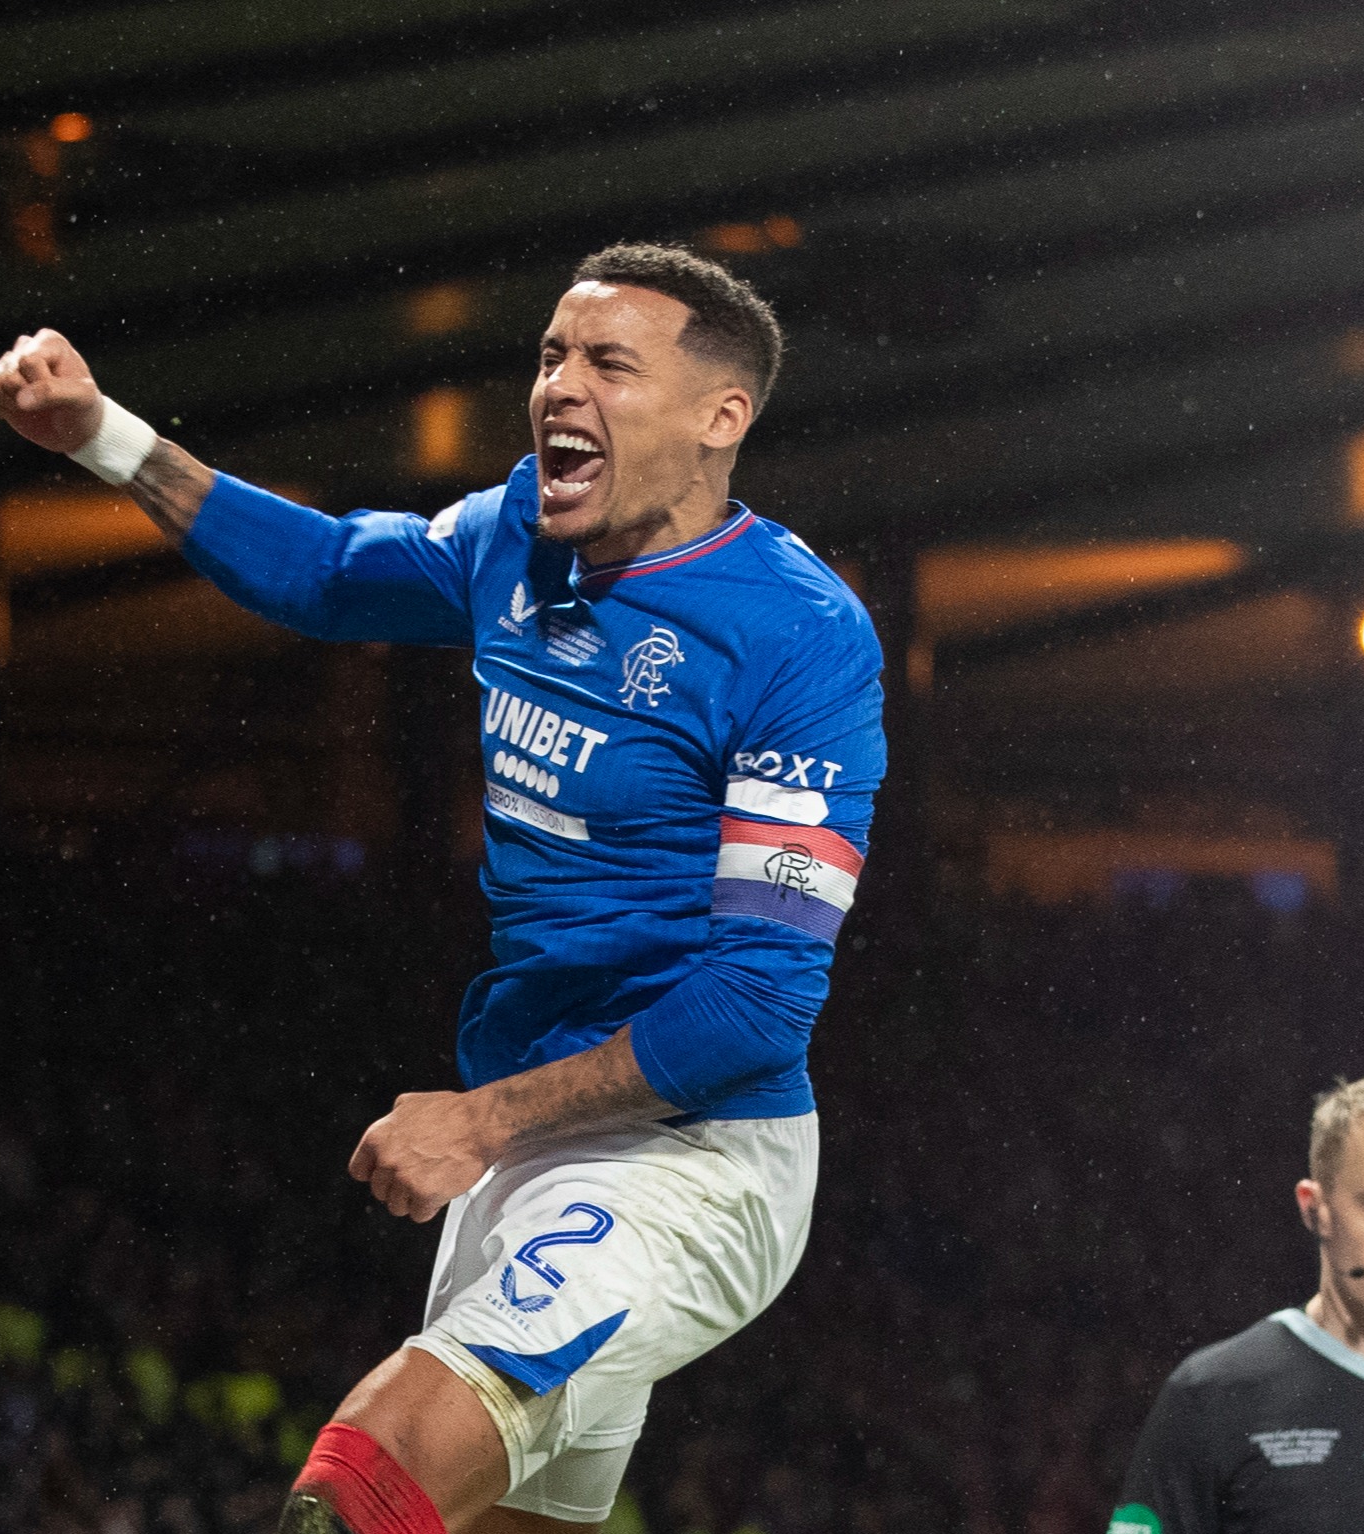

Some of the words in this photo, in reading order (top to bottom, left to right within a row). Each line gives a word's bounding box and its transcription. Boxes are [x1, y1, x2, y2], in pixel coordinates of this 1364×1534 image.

[485, 688, 609, 774] UNIBET
[513, 1202, 615, 1291] 2
[485, 1293, 532, 1333] CASTORE
